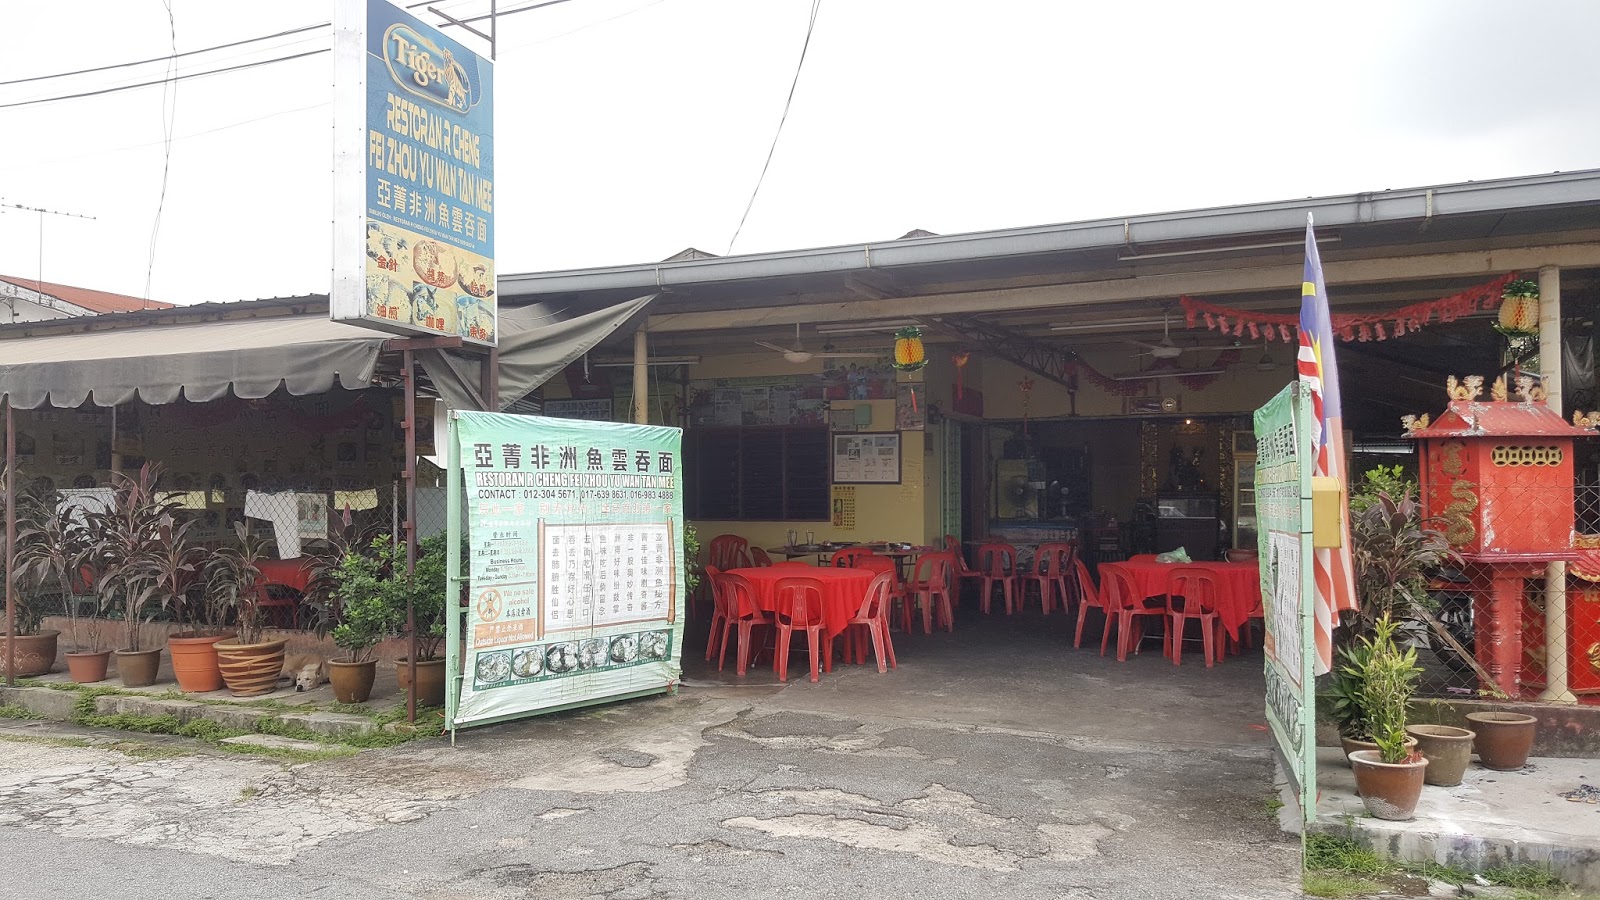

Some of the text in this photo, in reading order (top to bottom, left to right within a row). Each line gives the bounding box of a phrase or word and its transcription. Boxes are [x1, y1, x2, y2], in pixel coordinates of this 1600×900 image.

[392, 33, 445, 87] Tiger
[387, 92, 480, 169] RESTORAN R CHENG
[369, 129, 493, 214] FEI ZHOU YU WAN TAN MEE
[377, 177, 488, 244] 亞菁非洲魚雲吞面
[376, 255, 398, 272] 金針
[473, 443, 673, 473] 亞菁非洲魚雲吞面
[475, 471, 525, 487] RESTORAN
[526, 471, 534, 487] R
[535, 472, 568, 487] CHENG
[569, 472, 583, 488] FEI
[584, 473, 608, 488] ZHOU
[609, 474, 621, 488] YU
[641, 475, 657, 489] TAN
[658, 475, 675, 489] MEE
[478, 489, 516, 499] CONTACT
[523, 489, 556, 499] 012-304
[581, 490, 610, 499] 017-639
[630, 490, 656, 499] 016-983
[658, 491, 673, 500] 4888
[508, 598, 530, 606] alcohol
[475, 632, 534, 646] Outside Liquor Not Allowed
